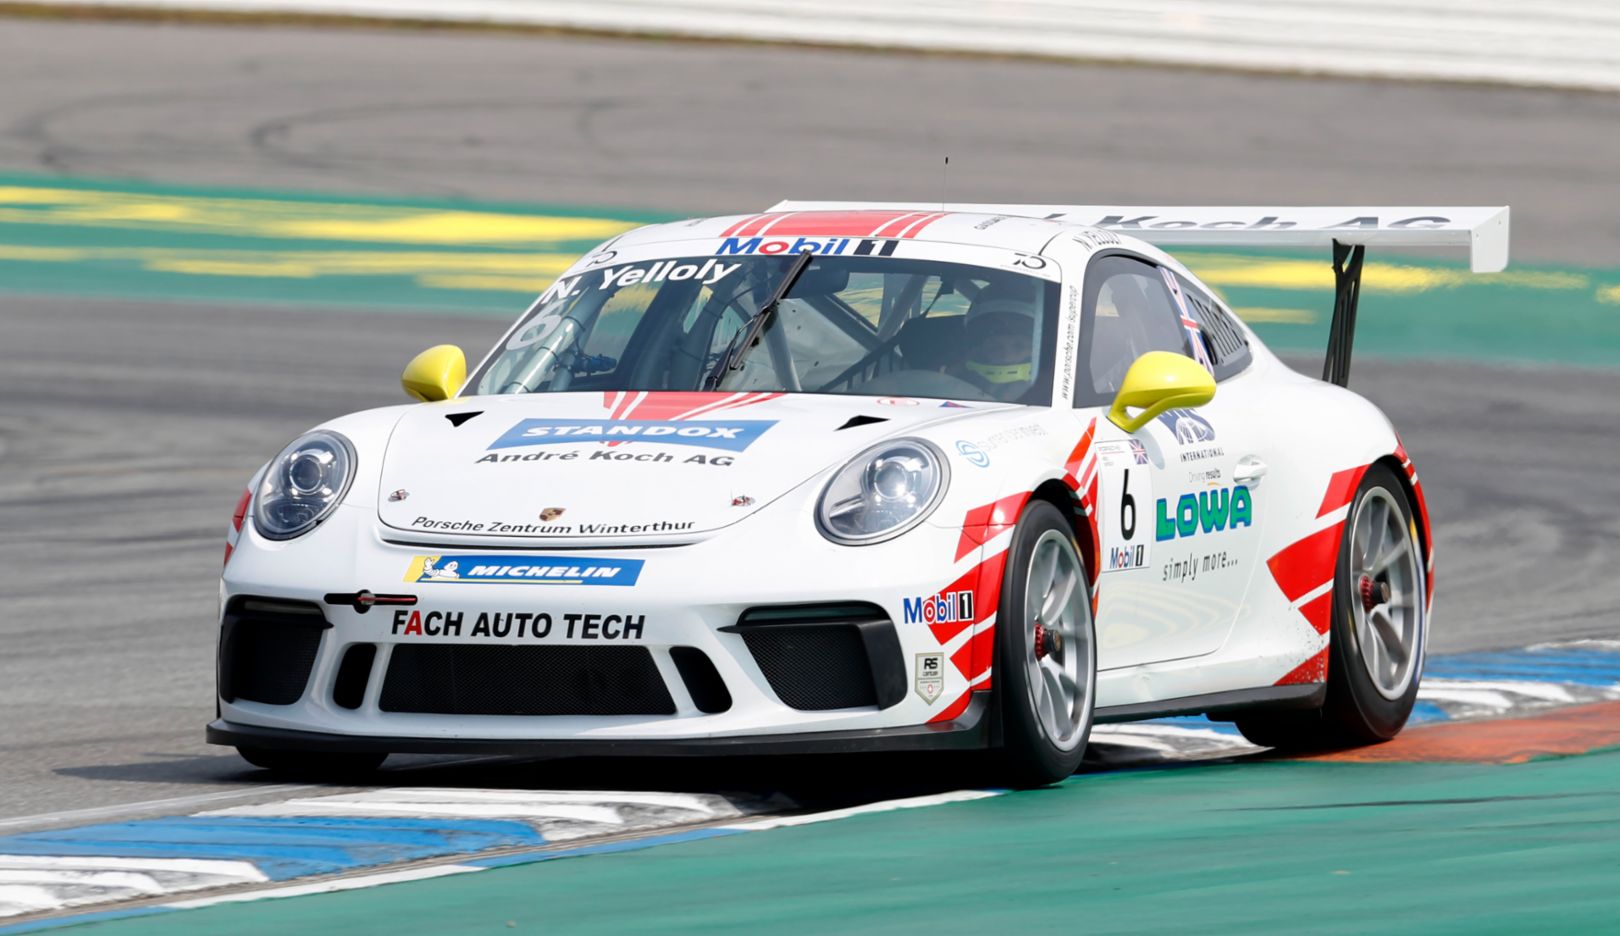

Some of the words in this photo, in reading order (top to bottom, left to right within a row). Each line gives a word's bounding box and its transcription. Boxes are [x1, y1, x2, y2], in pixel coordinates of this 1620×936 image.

[715, 237, 850, 255] Mobil
[857, 239, 895, 256] 1
[540, 276, 581, 304] N.
[599, 258, 742, 290] Yelloly
[521, 425, 745, 439] STANDOX
[474, 449, 580, 464] André
[588, 450, 675, 464] Koch
[683, 454, 736, 467] AG
[1180, 447, 1225, 463] INTERNATIONAL
[1120, 468, 1137, 541] 6
[1155, 485, 1252, 542] LOWA
[411, 516, 484, 532] Porsche
[487, 521, 572, 534] Zentrum
[578, 520, 695, 534] Winterthur
[1109, 546, 1134, 569] Mobil
[1135, 545, 1145, 567] 1
[467, 564, 622, 579] MICHELIN
[1163, 553, 1199, 583] simply
[903, 592, 957, 624] Mobil
[960, 592, 973, 620] 1
[391, 610, 464, 637] FACH
[470, 611, 552, 638] AUTO
[562, 613, 646, 639] TECH
[923, 657, 939, 670] RS
